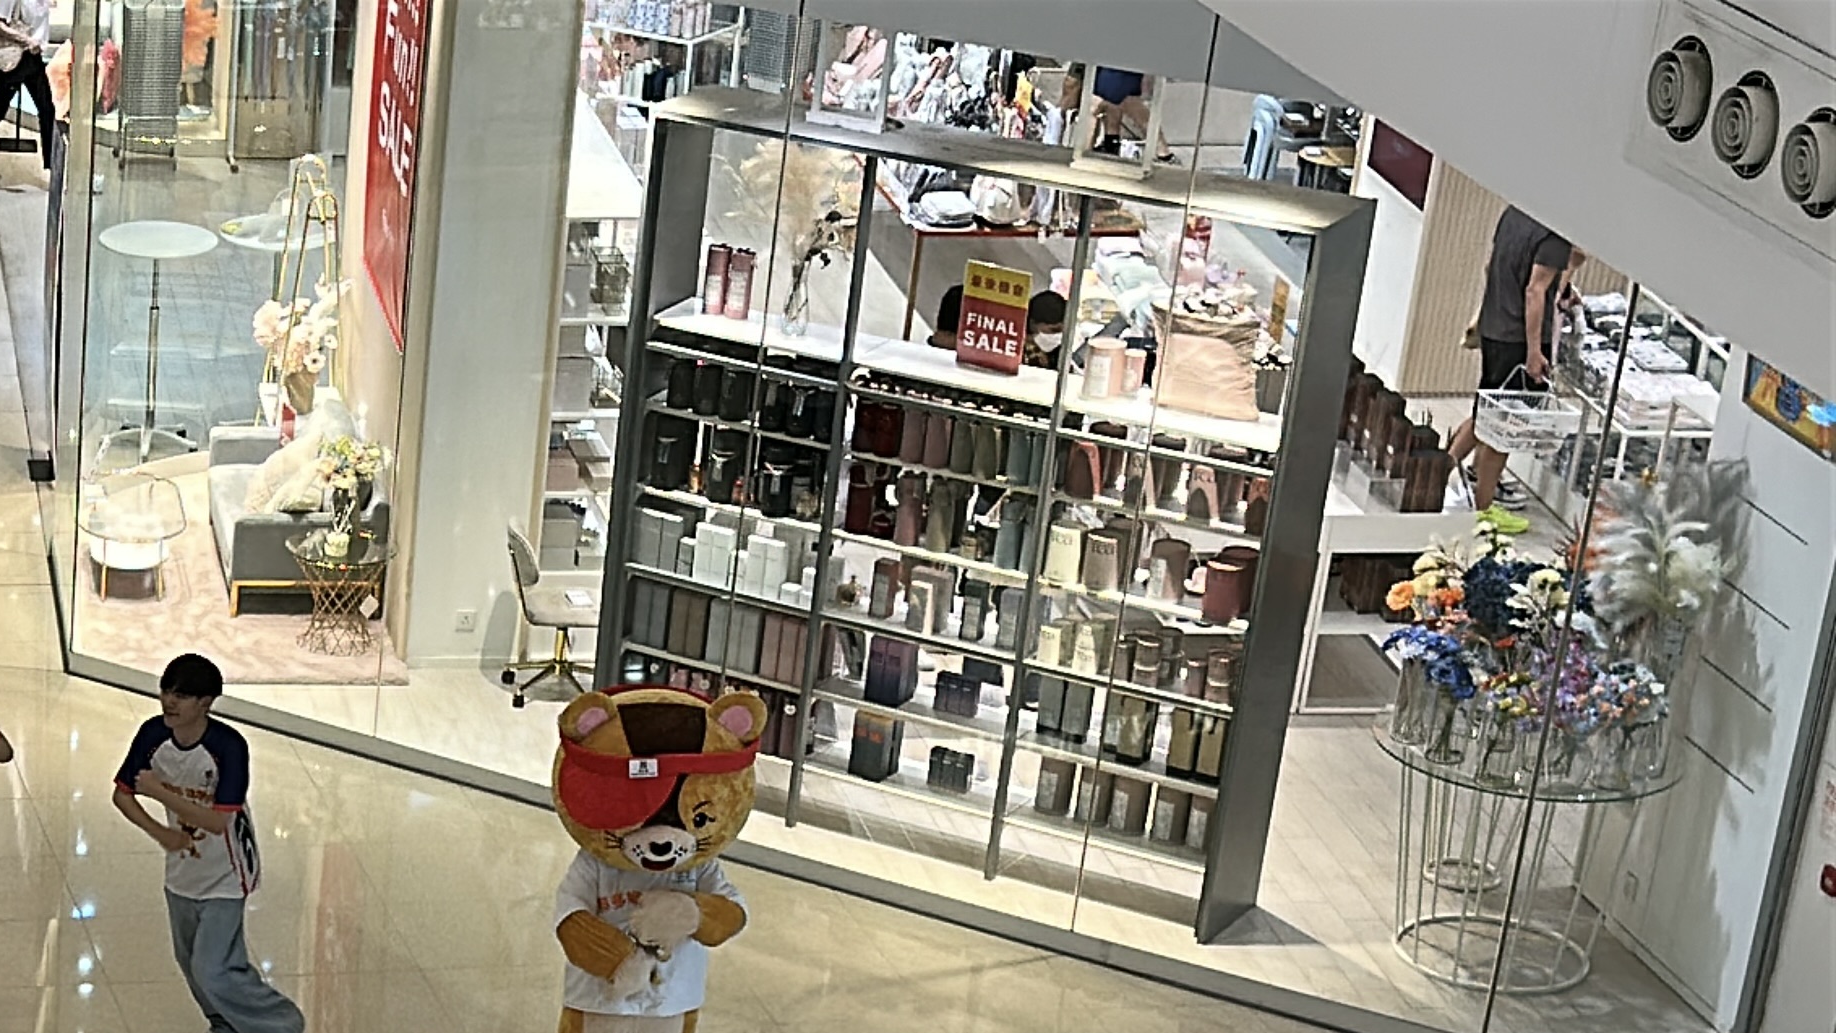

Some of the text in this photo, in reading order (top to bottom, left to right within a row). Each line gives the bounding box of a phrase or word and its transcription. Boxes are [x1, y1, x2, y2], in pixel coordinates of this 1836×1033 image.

[378, 80, 413, 198] SALE
[966, 312, 1018, 337] FINAL
[963, 330, 1019, 358] SALE
